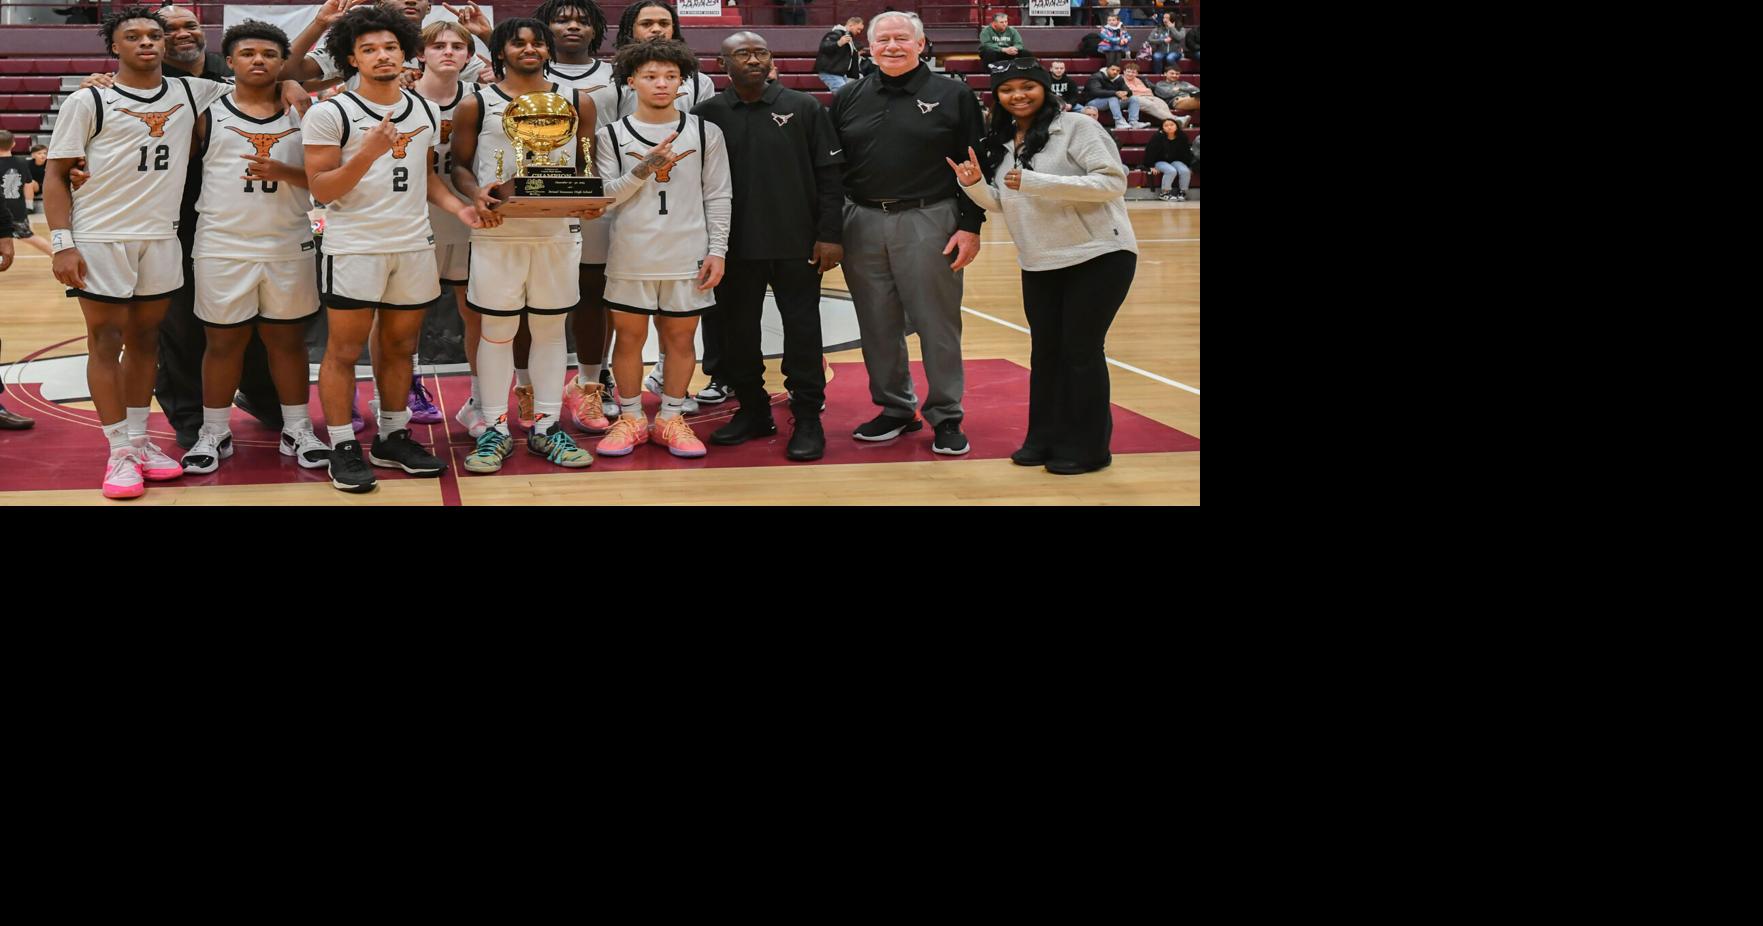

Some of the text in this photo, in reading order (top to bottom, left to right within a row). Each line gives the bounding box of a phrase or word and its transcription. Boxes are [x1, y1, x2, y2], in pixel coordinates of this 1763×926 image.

[137, 145, 170, 171] 12
[392, 166, 408, 192] 2
[658, 190, 668, 215] 1
